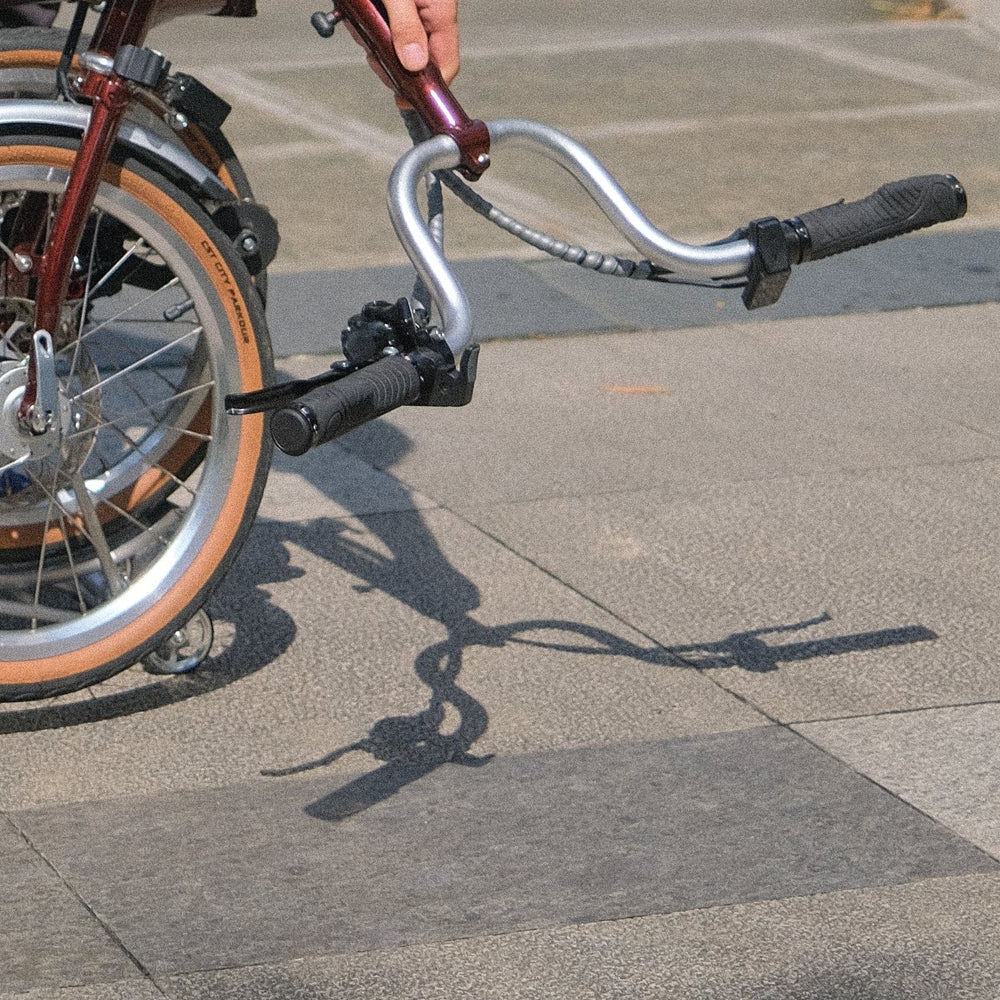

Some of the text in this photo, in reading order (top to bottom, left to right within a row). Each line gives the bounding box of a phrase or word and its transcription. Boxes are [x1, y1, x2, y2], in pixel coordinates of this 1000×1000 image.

[201, 240, 250, 344] CST CITY PARKOUR
